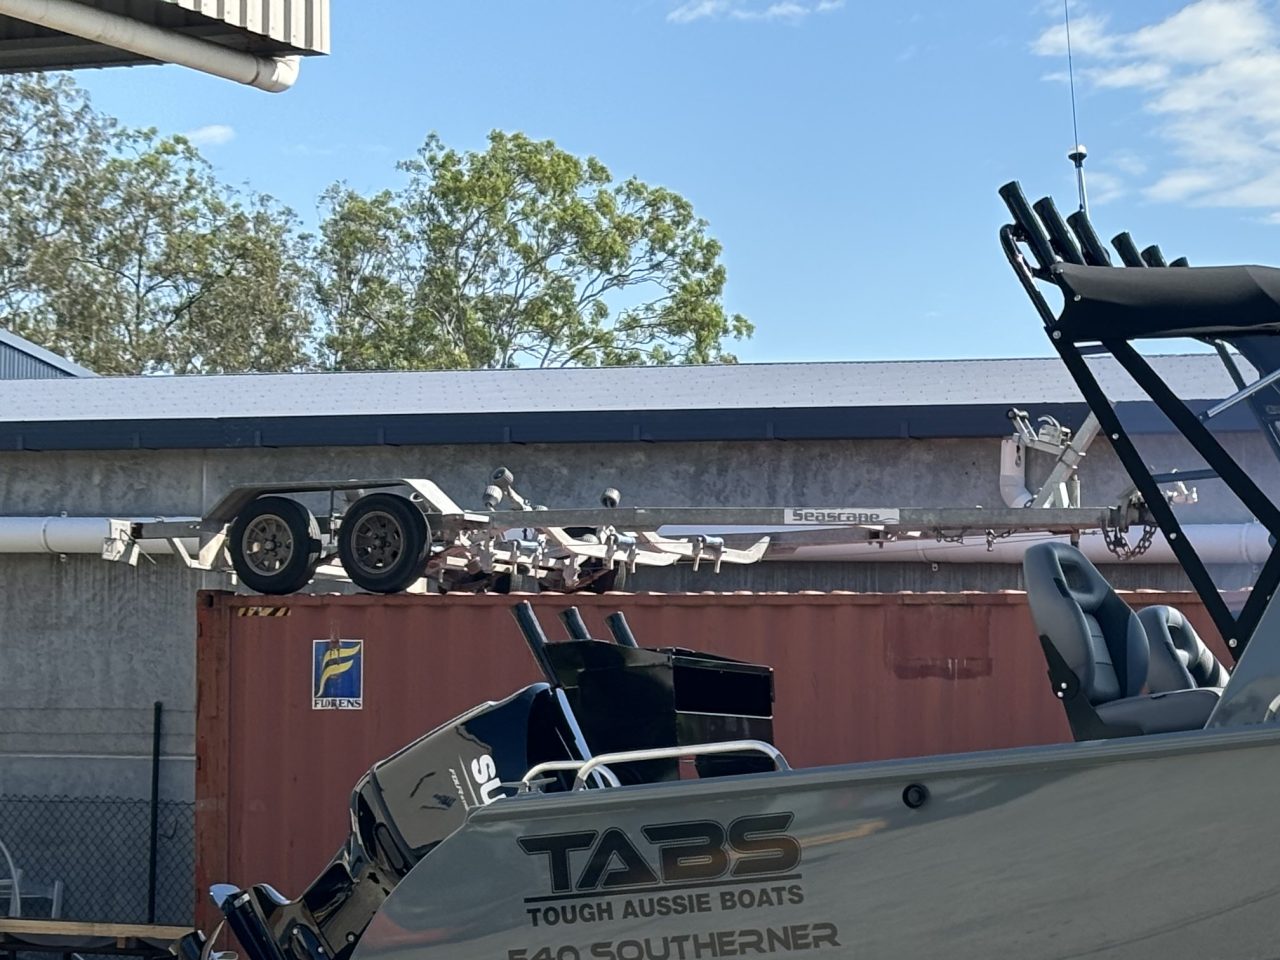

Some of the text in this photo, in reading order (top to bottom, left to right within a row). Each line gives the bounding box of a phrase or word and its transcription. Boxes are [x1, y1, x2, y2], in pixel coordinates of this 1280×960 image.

[792, 508, 880, 525] Seascape
[314, 699, 362, 708] FLORENS
[517, 811, 802, 893] TABS
[526, 885, 805, 927] TOUGH AUSSIE BOATS
